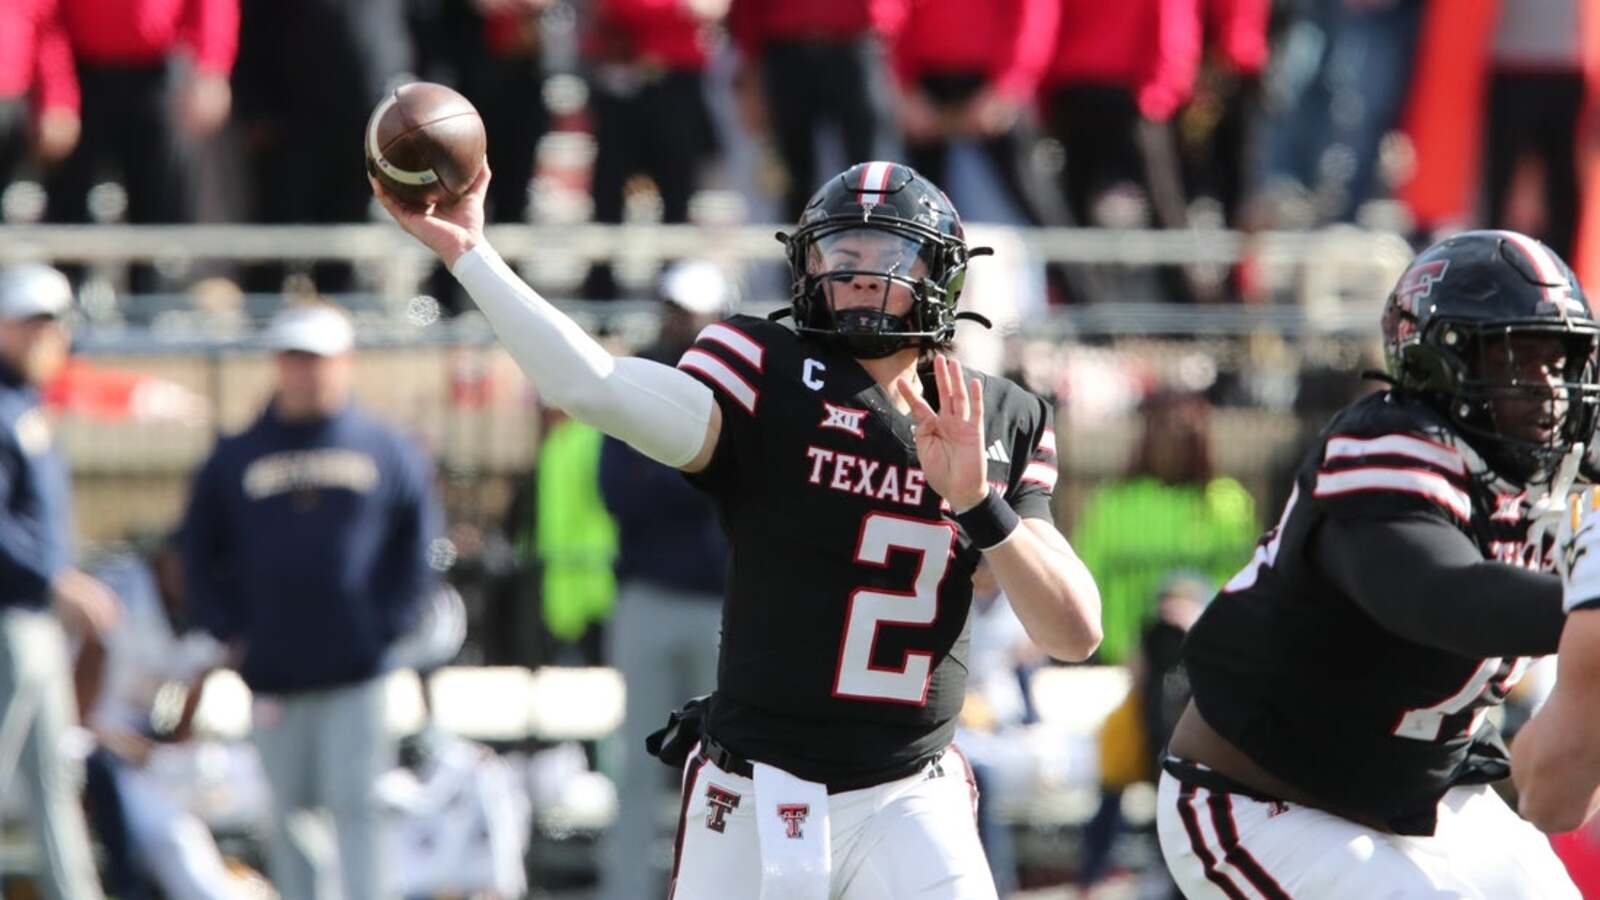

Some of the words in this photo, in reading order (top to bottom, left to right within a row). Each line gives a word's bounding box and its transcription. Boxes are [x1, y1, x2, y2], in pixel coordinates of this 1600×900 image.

[802, 357, 826, 391] C
[806, 446, 926, 506] TEXAS
[833, 511, 957, 706] 2
